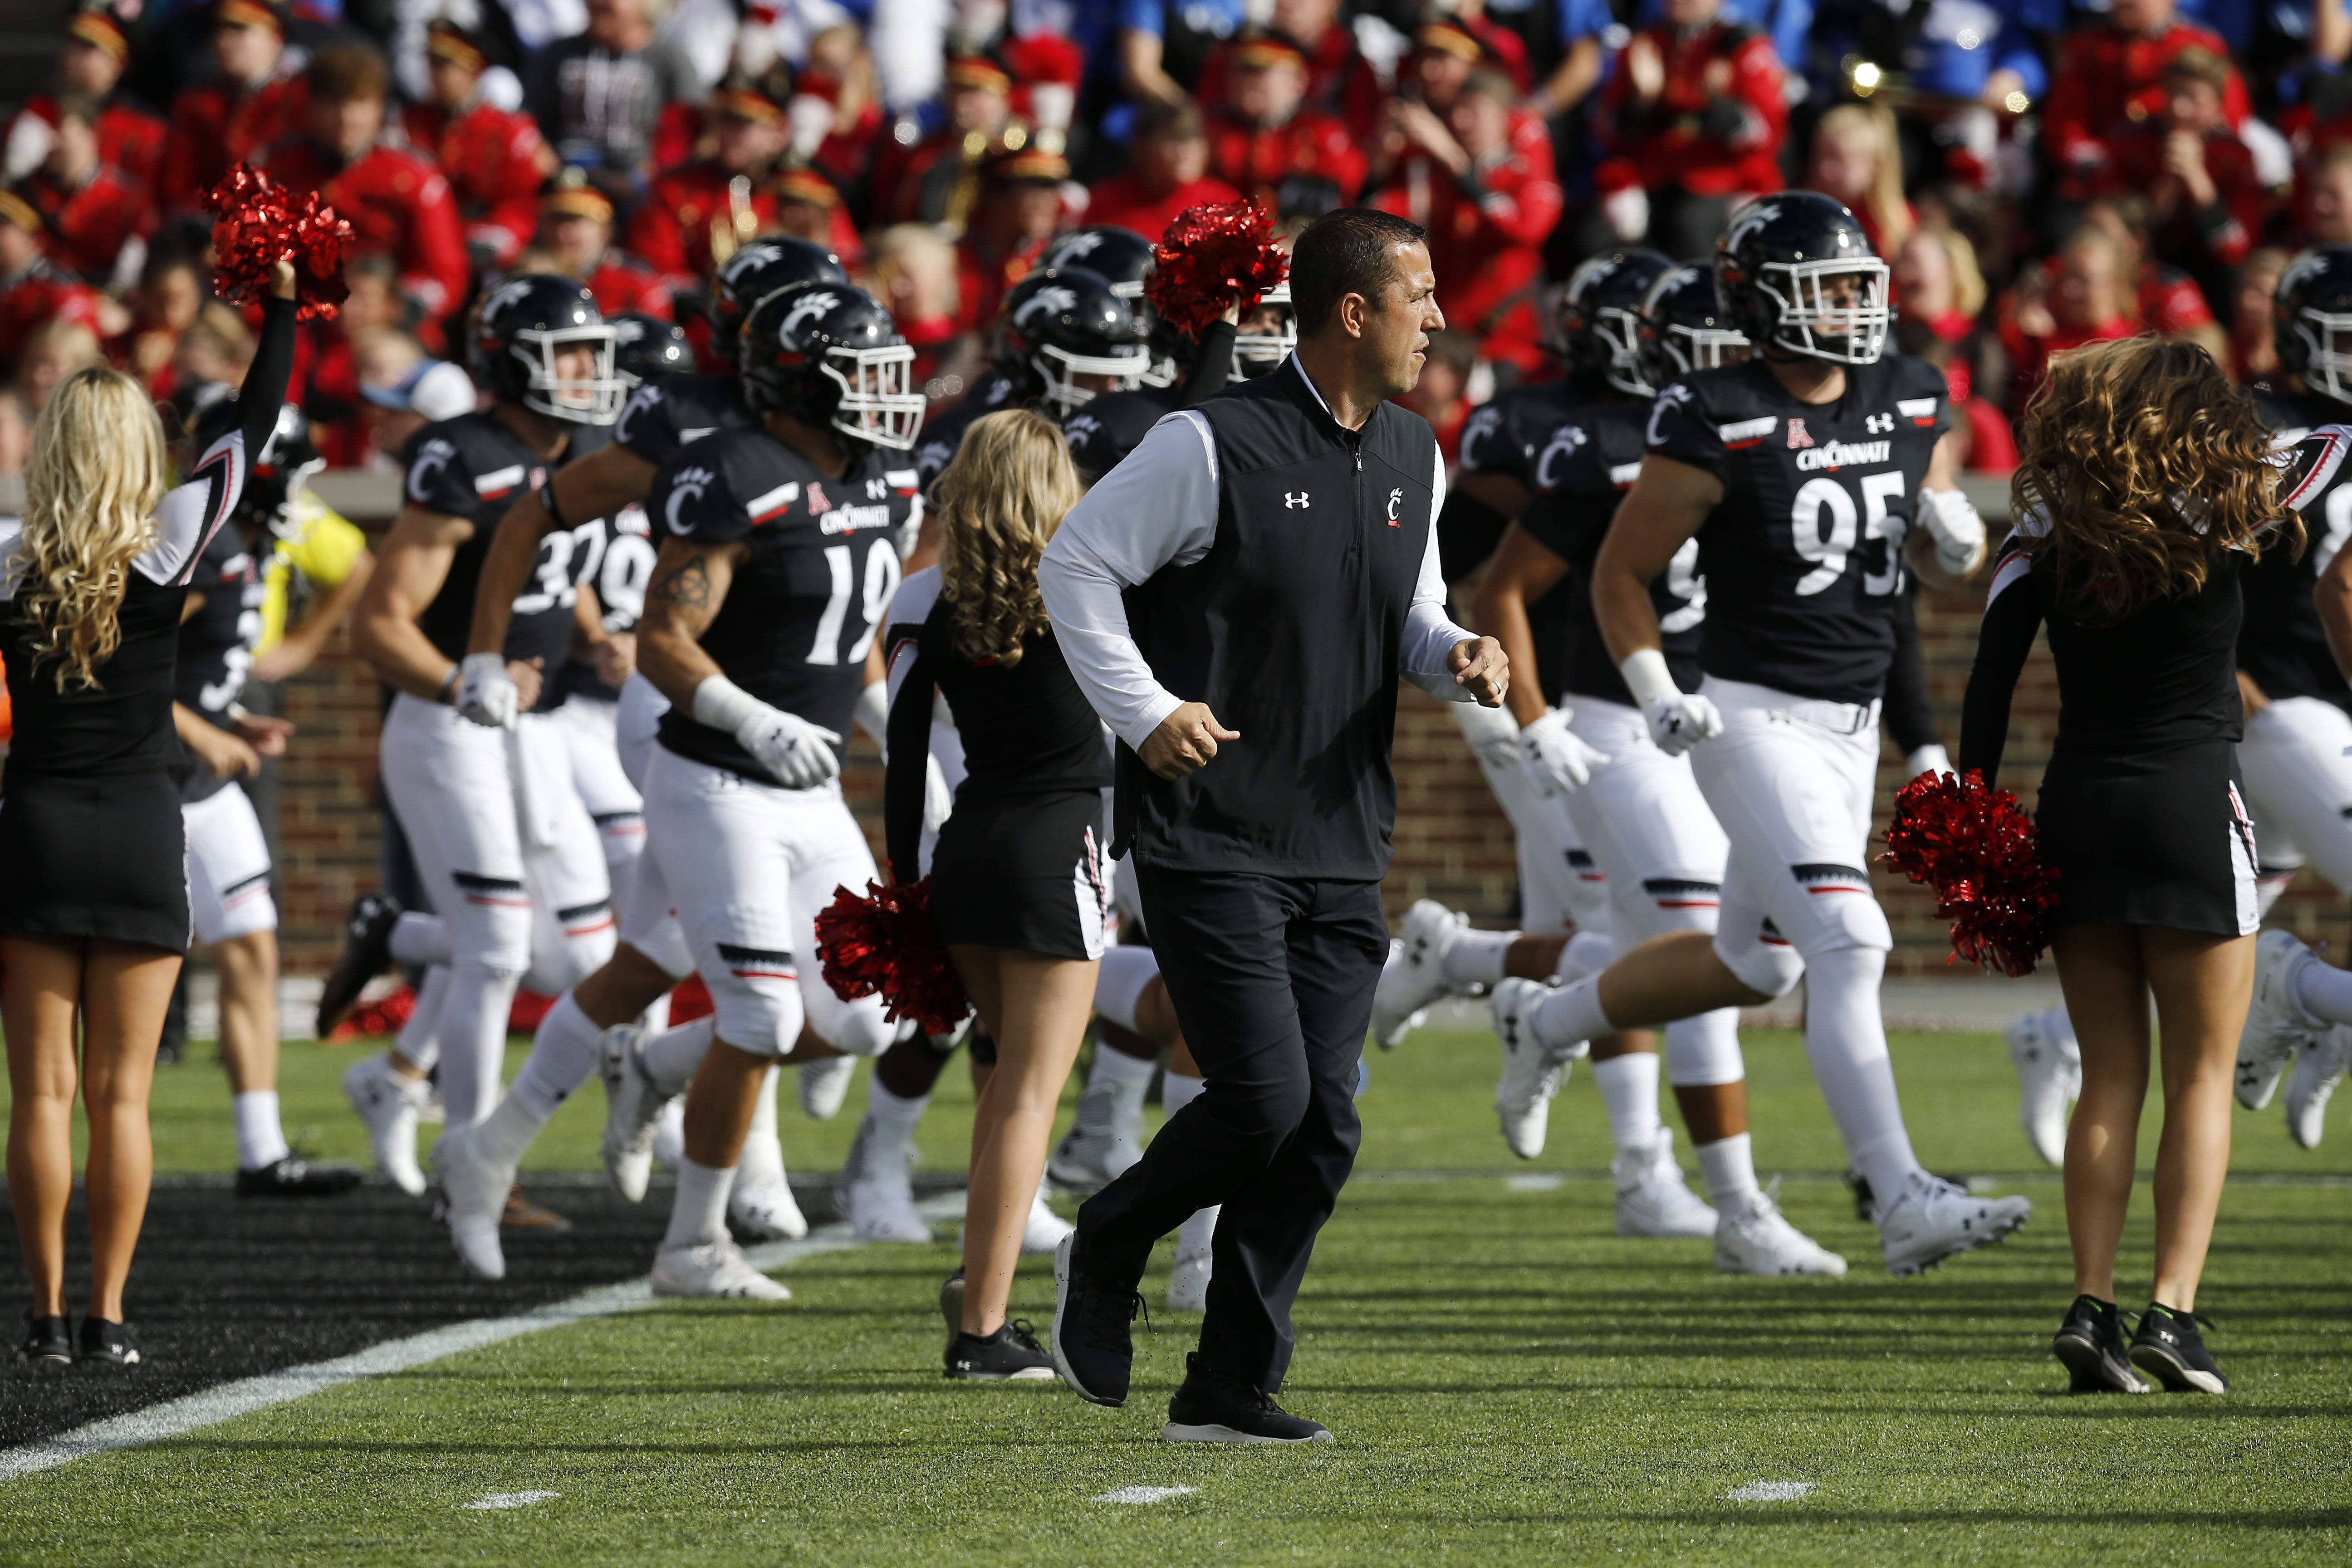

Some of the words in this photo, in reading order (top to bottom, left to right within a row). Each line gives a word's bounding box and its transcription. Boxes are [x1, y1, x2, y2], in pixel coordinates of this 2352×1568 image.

[615, 385, 662, 443] C
[1651, 383, 1695, 446] C
[408, 438, 455, 501] C
[1536, 426, 1588, 487] C
[665, 466, 715, 535] C
[1387, 487, 1403, 520] C
[1791, 470, 1906, 596] 95
[512, 517, 607, 613] 37
[805, 537, 902, 665] 19
